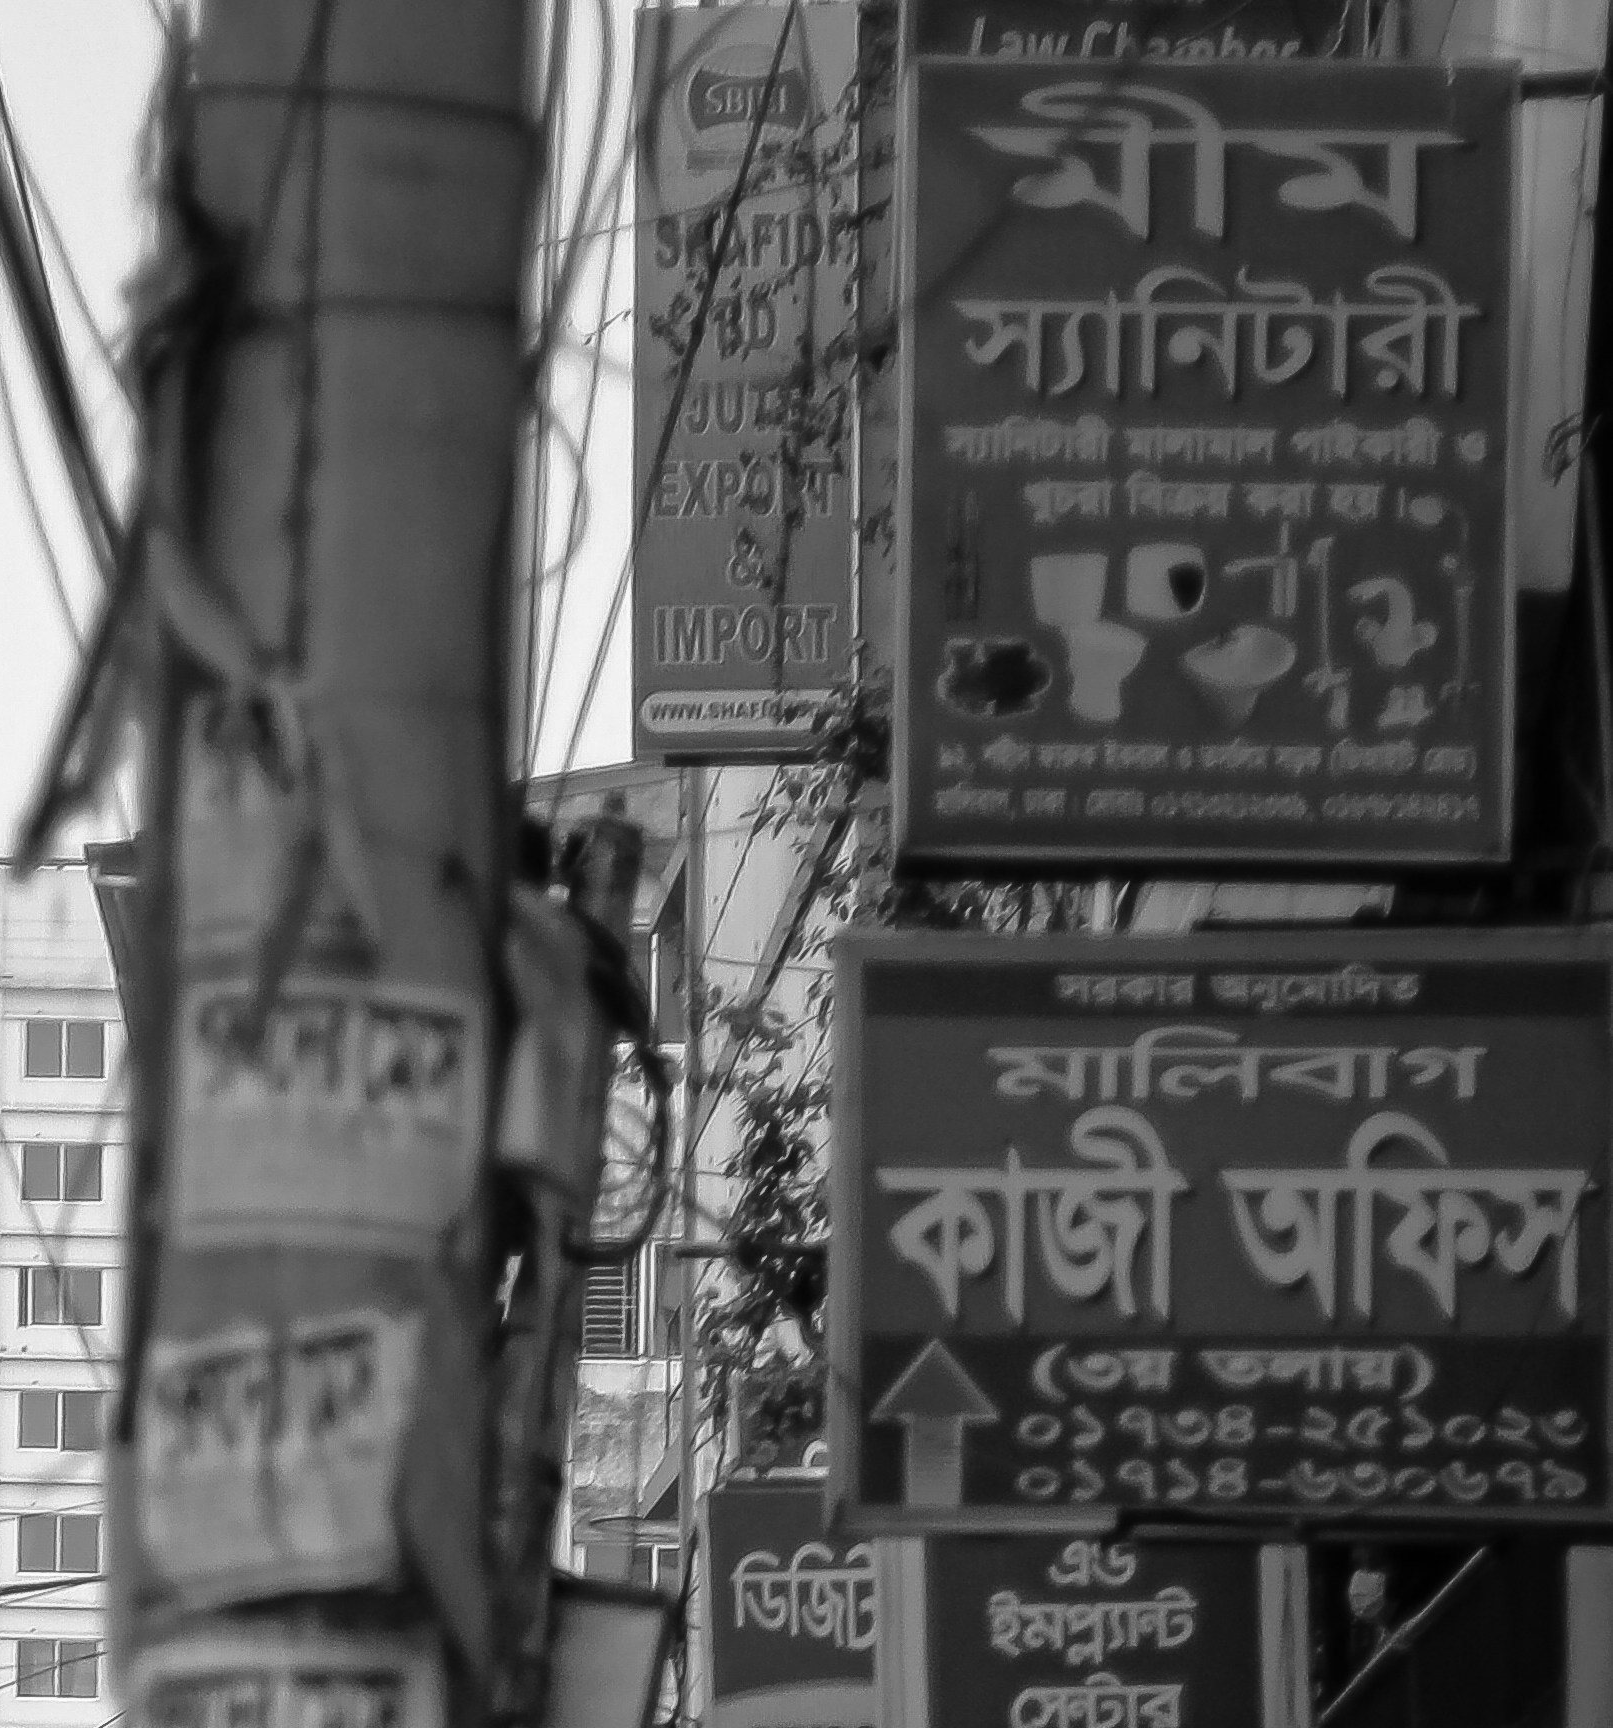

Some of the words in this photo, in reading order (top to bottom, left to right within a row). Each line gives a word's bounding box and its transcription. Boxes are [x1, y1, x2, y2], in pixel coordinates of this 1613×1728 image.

[951, 264, 1484, 399] স্যানিটারী
[654, 604, 838, 665] IMPORT
[987, 1024, 1487, 1101] মালিবাগ
[875, 1105, 1189, 1325] কাজী
[1219, 1110, 1590, 1322] অফিস
